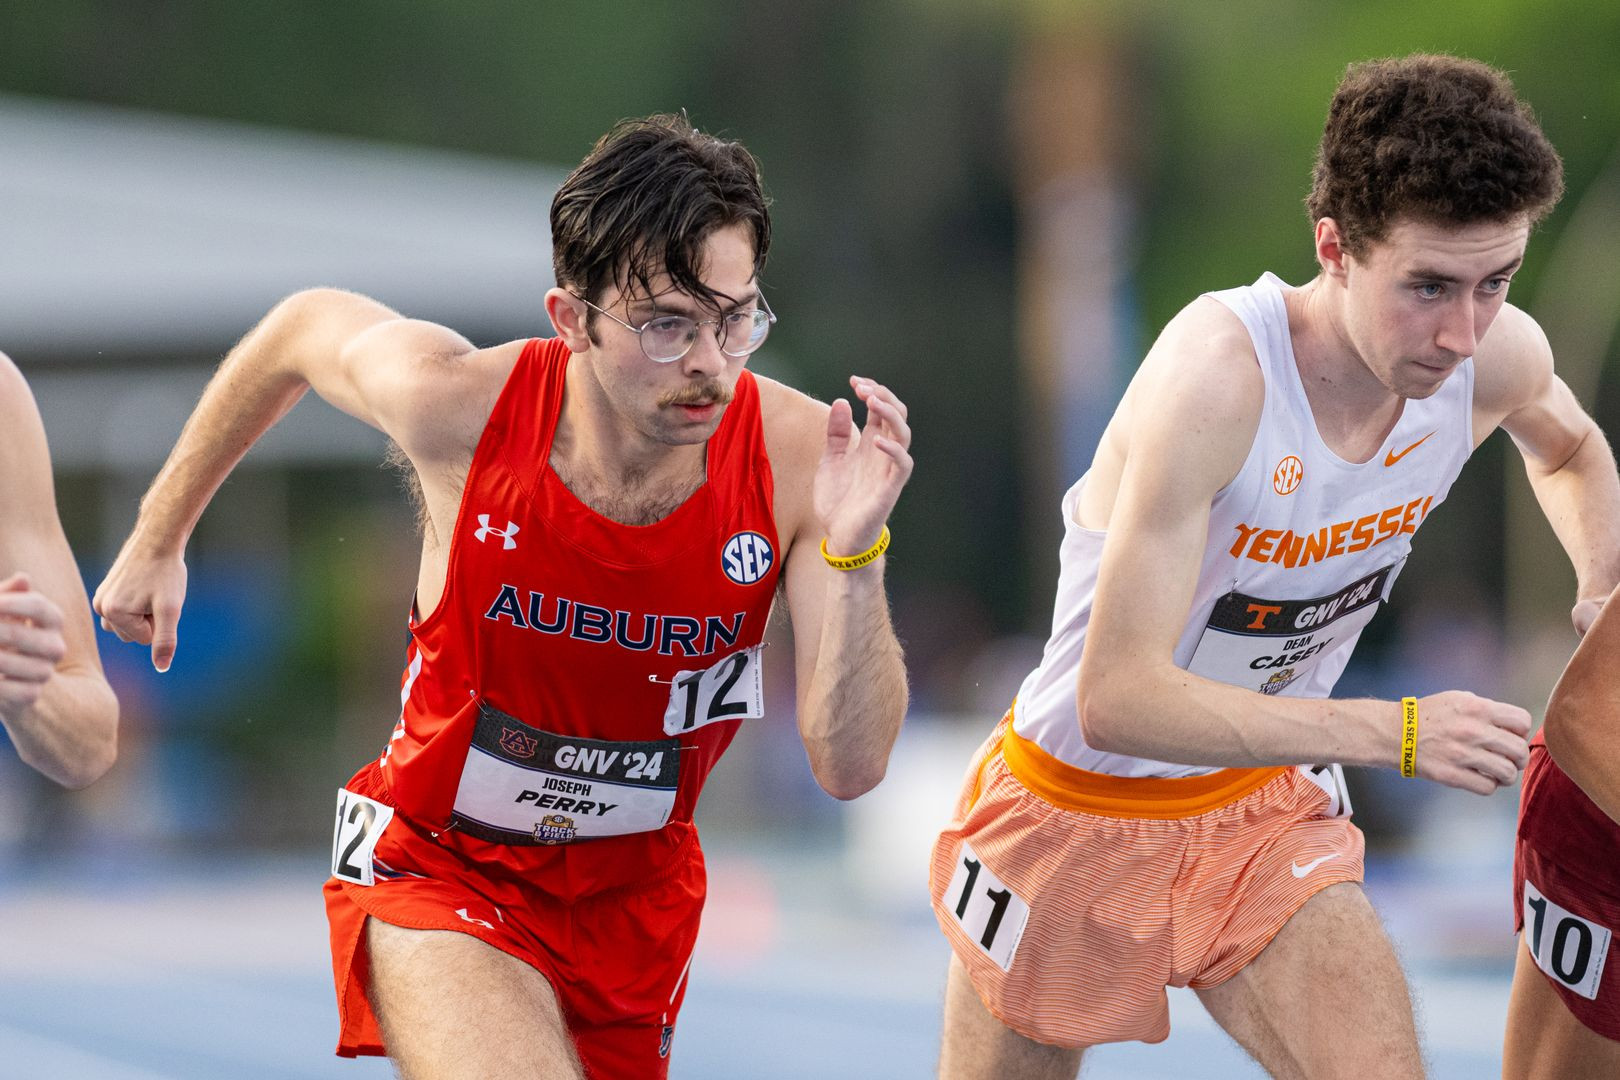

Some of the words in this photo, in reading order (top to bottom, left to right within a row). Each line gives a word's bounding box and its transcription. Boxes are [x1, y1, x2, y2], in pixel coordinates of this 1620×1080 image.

[1274, 456, 1303, 495] SEC
[723, 533, 771, 583] SEC
[852, 549, 879, 567] FIELD
[484, 584, 747, 656] AUBURN
[1247, 603, 1281, 630] T
[1294, 592, 1349, 629] GNV
[1249, 637, 1335, 670] CASEY
[1283, 634, 1314, 651] DEAN
[678, 652, 749, 730] 12
[1406, 707, 1415, 725] 2024
[1405, 726, 1415, 745] SEC
[554, 745, 620, 775] GNV
[542, 777, 592, 796] JOSEPH
[515, 789, 619, 817] PERRY
[536, 824, 575, 835] TRACK
[544, 831, 574, 839] FIELD
[955, 856, 1012, 951] 11
[1528, 896, 1593, 985] 10
